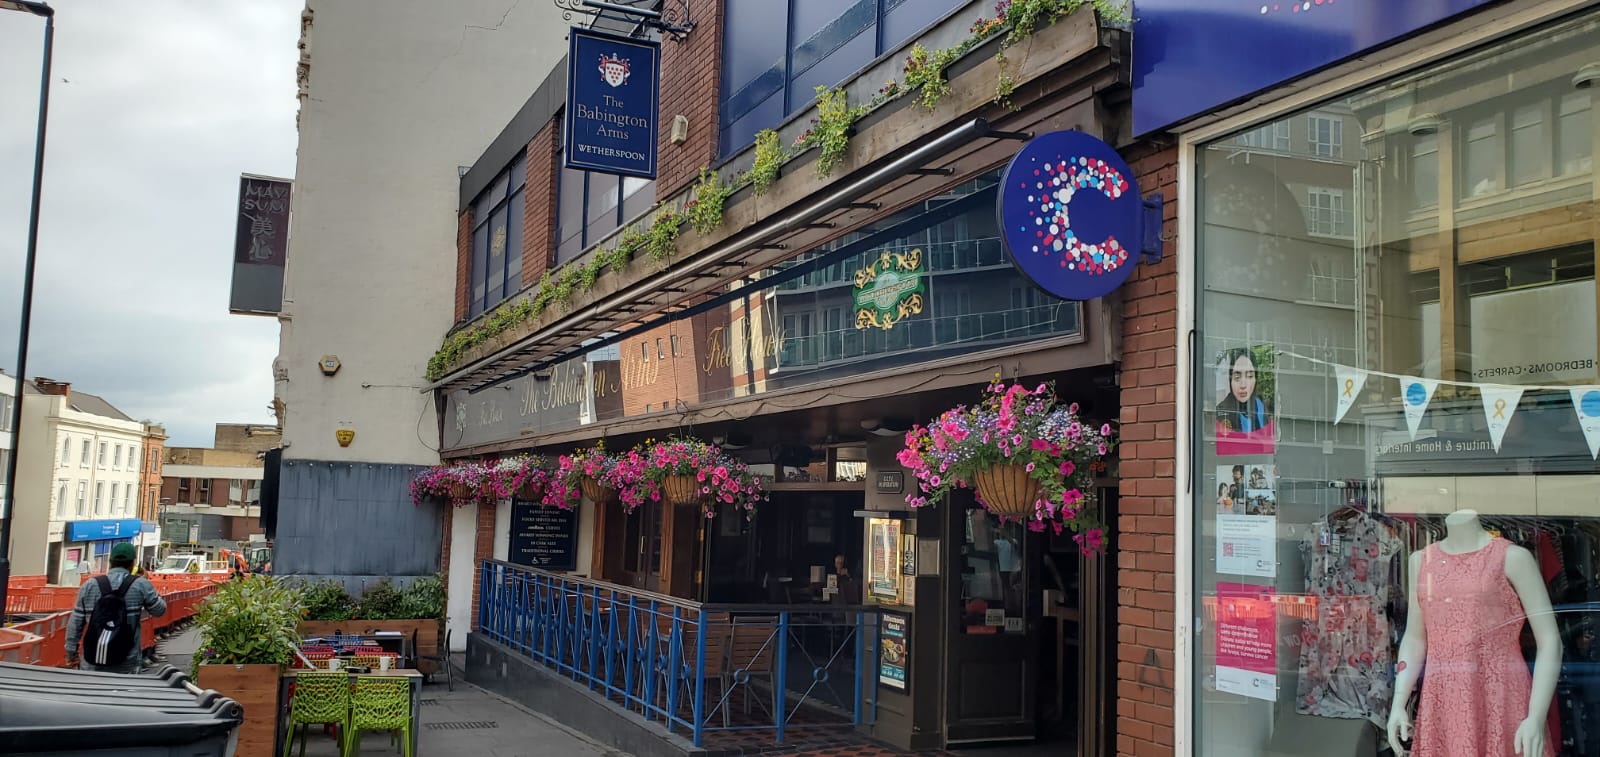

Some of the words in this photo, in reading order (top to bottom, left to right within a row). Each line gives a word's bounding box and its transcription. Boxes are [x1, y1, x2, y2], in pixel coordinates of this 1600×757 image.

[603, 95, 624, 108] The
[577, 103, 648, 128] Babington
[596, 124, 629, 140] Arms
[578, 144, 645, 161] WETHERSPOON
[519, 371, 538, 417] The
[541, 360, 606, 411] Babingon
